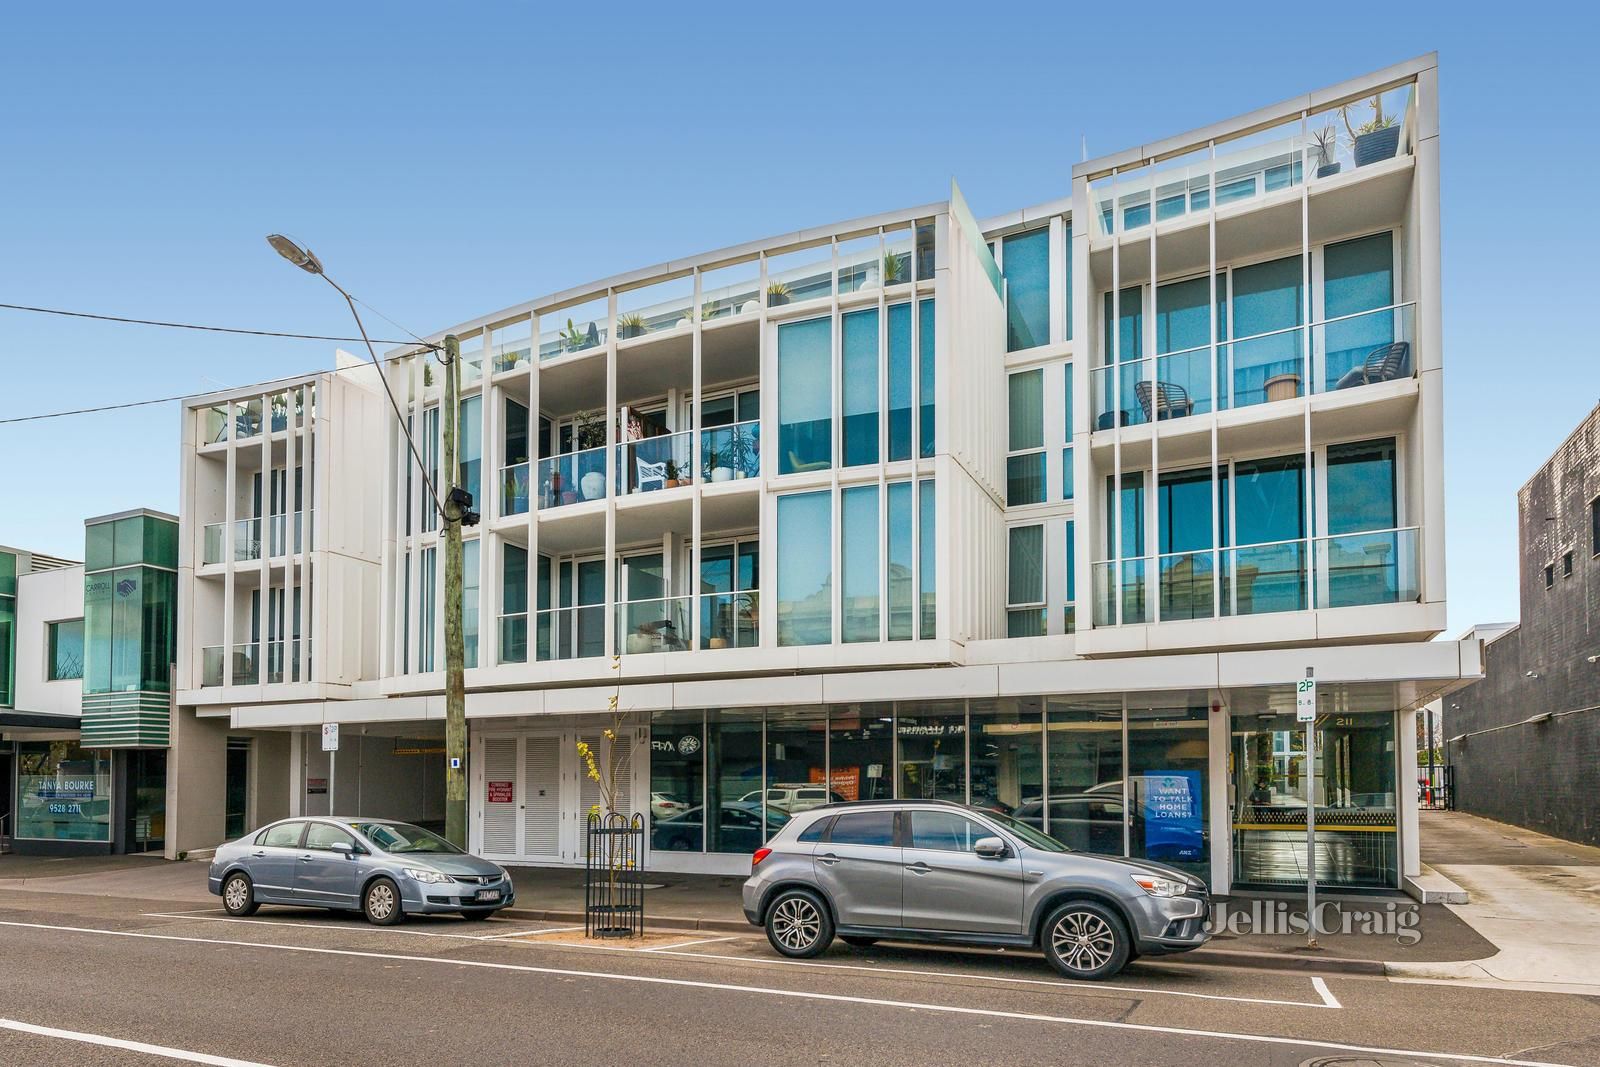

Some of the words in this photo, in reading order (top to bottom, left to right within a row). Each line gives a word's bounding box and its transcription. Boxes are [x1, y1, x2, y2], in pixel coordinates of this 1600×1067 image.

[86, 582, 111, 592] CARROLL
[1298, 681, 1313, 692] 2P
[1336, 717, 1353, 726] 211
[39, 781, 62, 790] TANYA
[64, 780, 94, 790] BOURKE
[1153, 795, 1166, 803] TO
[1170, 795, 1193, 803] TALK
[49, 803, 66, 813] 9528
[1159, 803, 1187, 811] HOME
[1155, 811, 1192, 819] LOANS?
